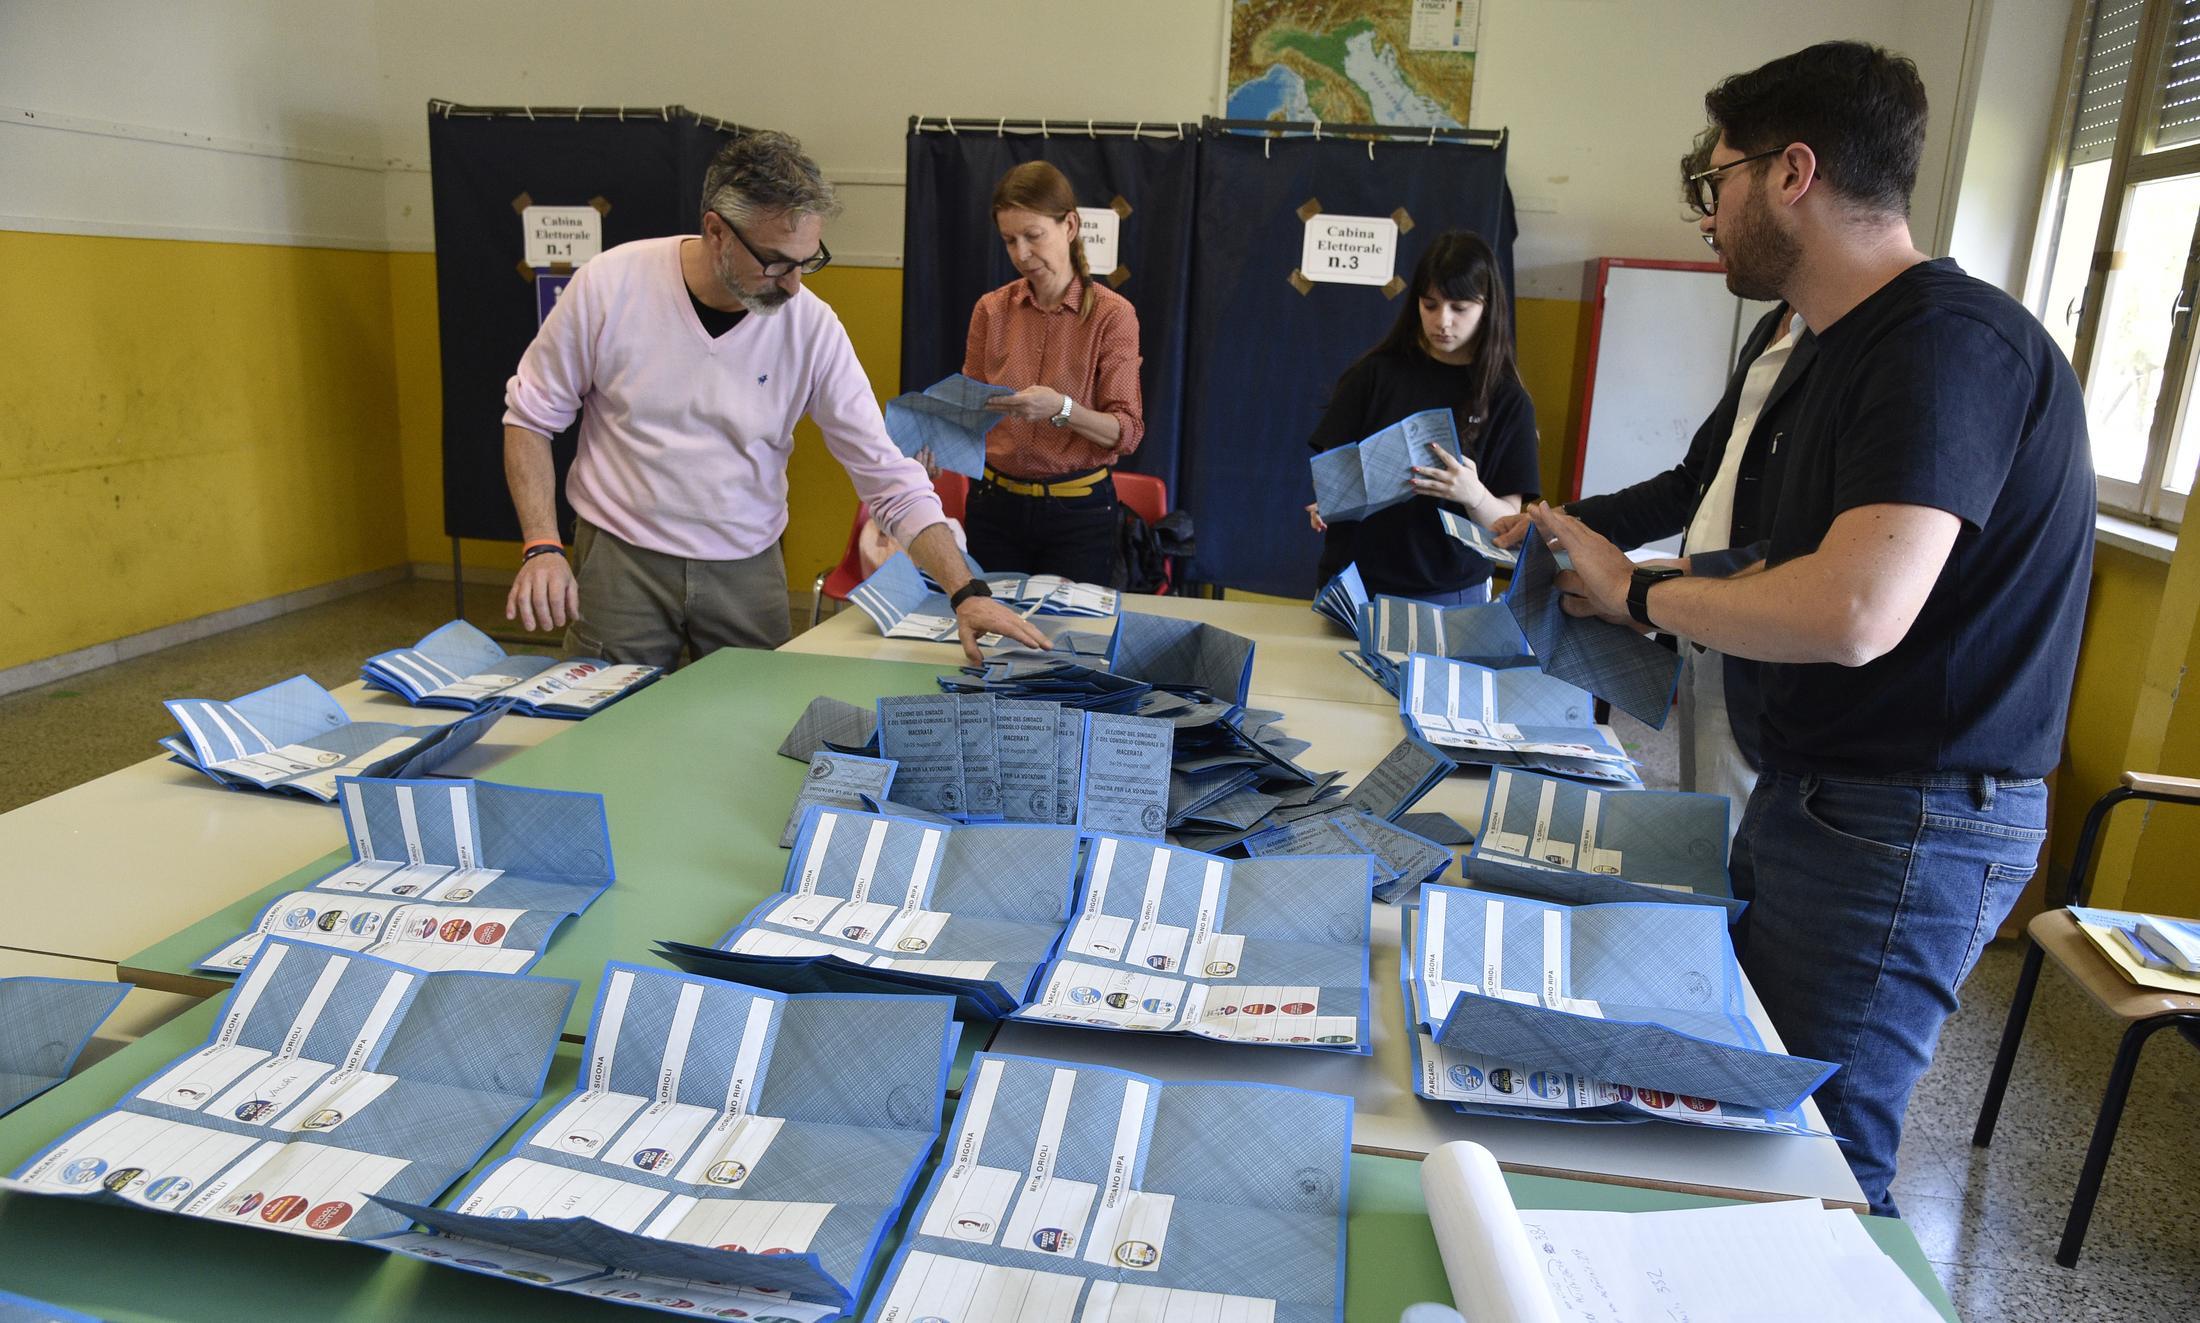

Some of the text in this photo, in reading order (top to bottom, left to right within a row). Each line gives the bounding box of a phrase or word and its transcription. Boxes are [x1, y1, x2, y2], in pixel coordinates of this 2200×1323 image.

[542, 216, 583, 227] Cabina
[536, 229, 591, 240] Elettorale
[1327, 226, 1375, 239] Cabina
[1317, 240, 1383, 254] Elettorale
[1116, 749, 1143, 757] MACERATA
[1132, 787, 1158, 795] VOTAZIONE
[803, 869, 813, 893] SIGONA
[855, 878, 865, 899] ORIOLI
[910, 885, 918, 898] RIPA
[1088, 890, 1098, 912] SIGONA
[1144, 899, 1153, 920] ORIOLI
[386, 910, 405, 941] TITTARELLI
[1428, 953, 1436, 978] SIGONA
[222, 1012, 241, 1042] SIGONA
[285, 1026, 303, 1053] ORIOLI
[354, 1039, 368, 1056] RIPA
[594, 1056, 605, 1089] SIGONA
[661, 1068, 672, 1098] ORIOLI
[733, 1078, 744, 1098] RIPA
[960, 1132, 975, 1162] SIGONA
[23, 1148, 68, 1184] PARCAROLI
[1036, 1144, 1049, 1173] ORIOLI
[1115, 1155, 1125, 1174] RIPA
[186, 1181, 227, 1213] TITTARELLI
[1041, 1231, 1050, 1248] TERZO
[1048, 1231, 1056, 1245] POLO
